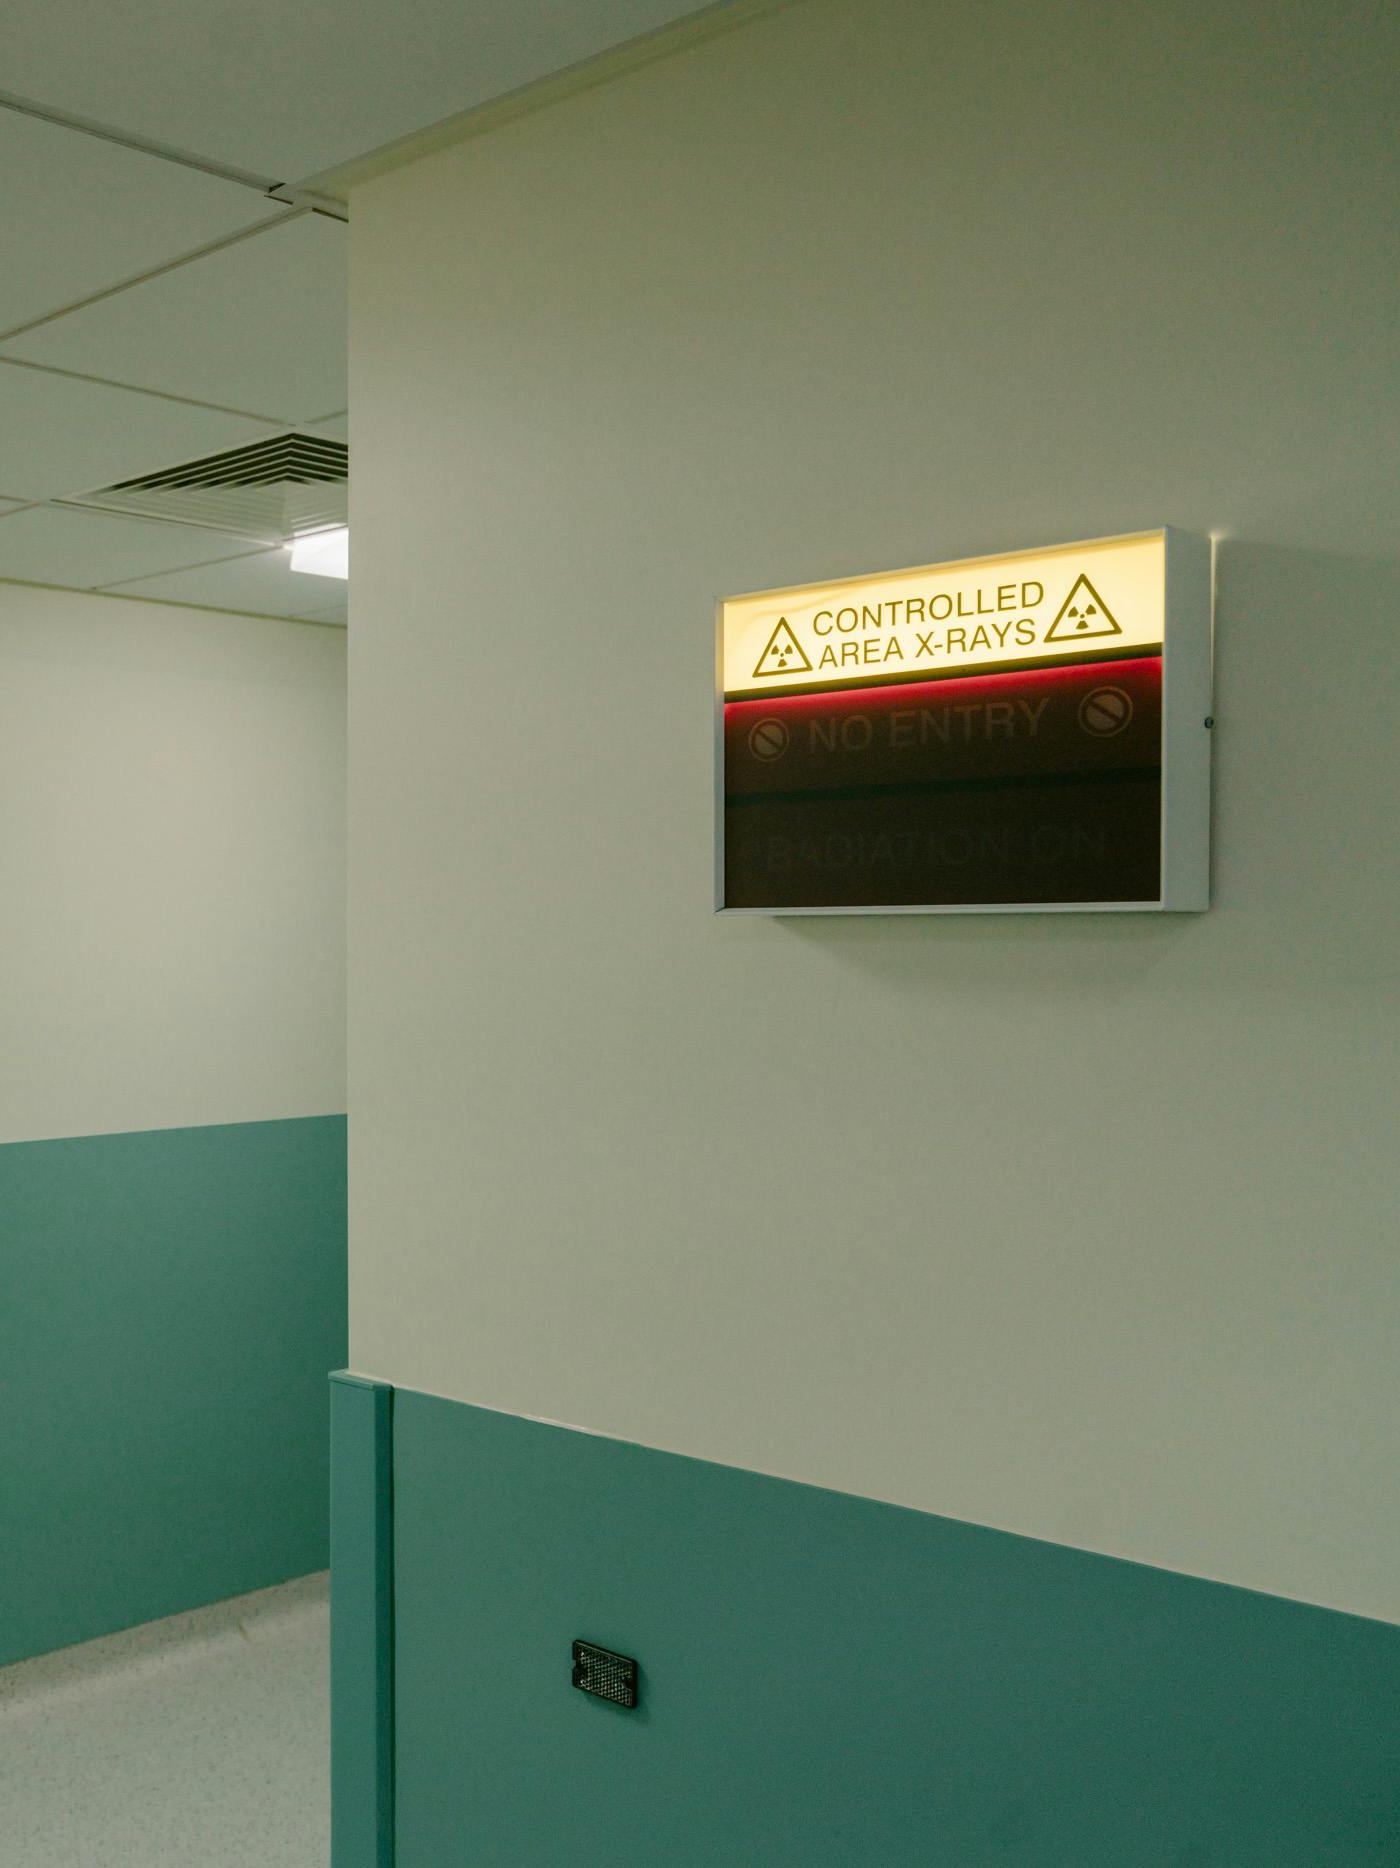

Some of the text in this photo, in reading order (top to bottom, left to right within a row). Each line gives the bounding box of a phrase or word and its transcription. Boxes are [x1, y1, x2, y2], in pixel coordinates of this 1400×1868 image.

[813, 581, 1044, 636] CONTROLLED
[818, 618, 1036, 670] AREA X-RAYS
[808, 697, 1050, 754] NO ENTRY
